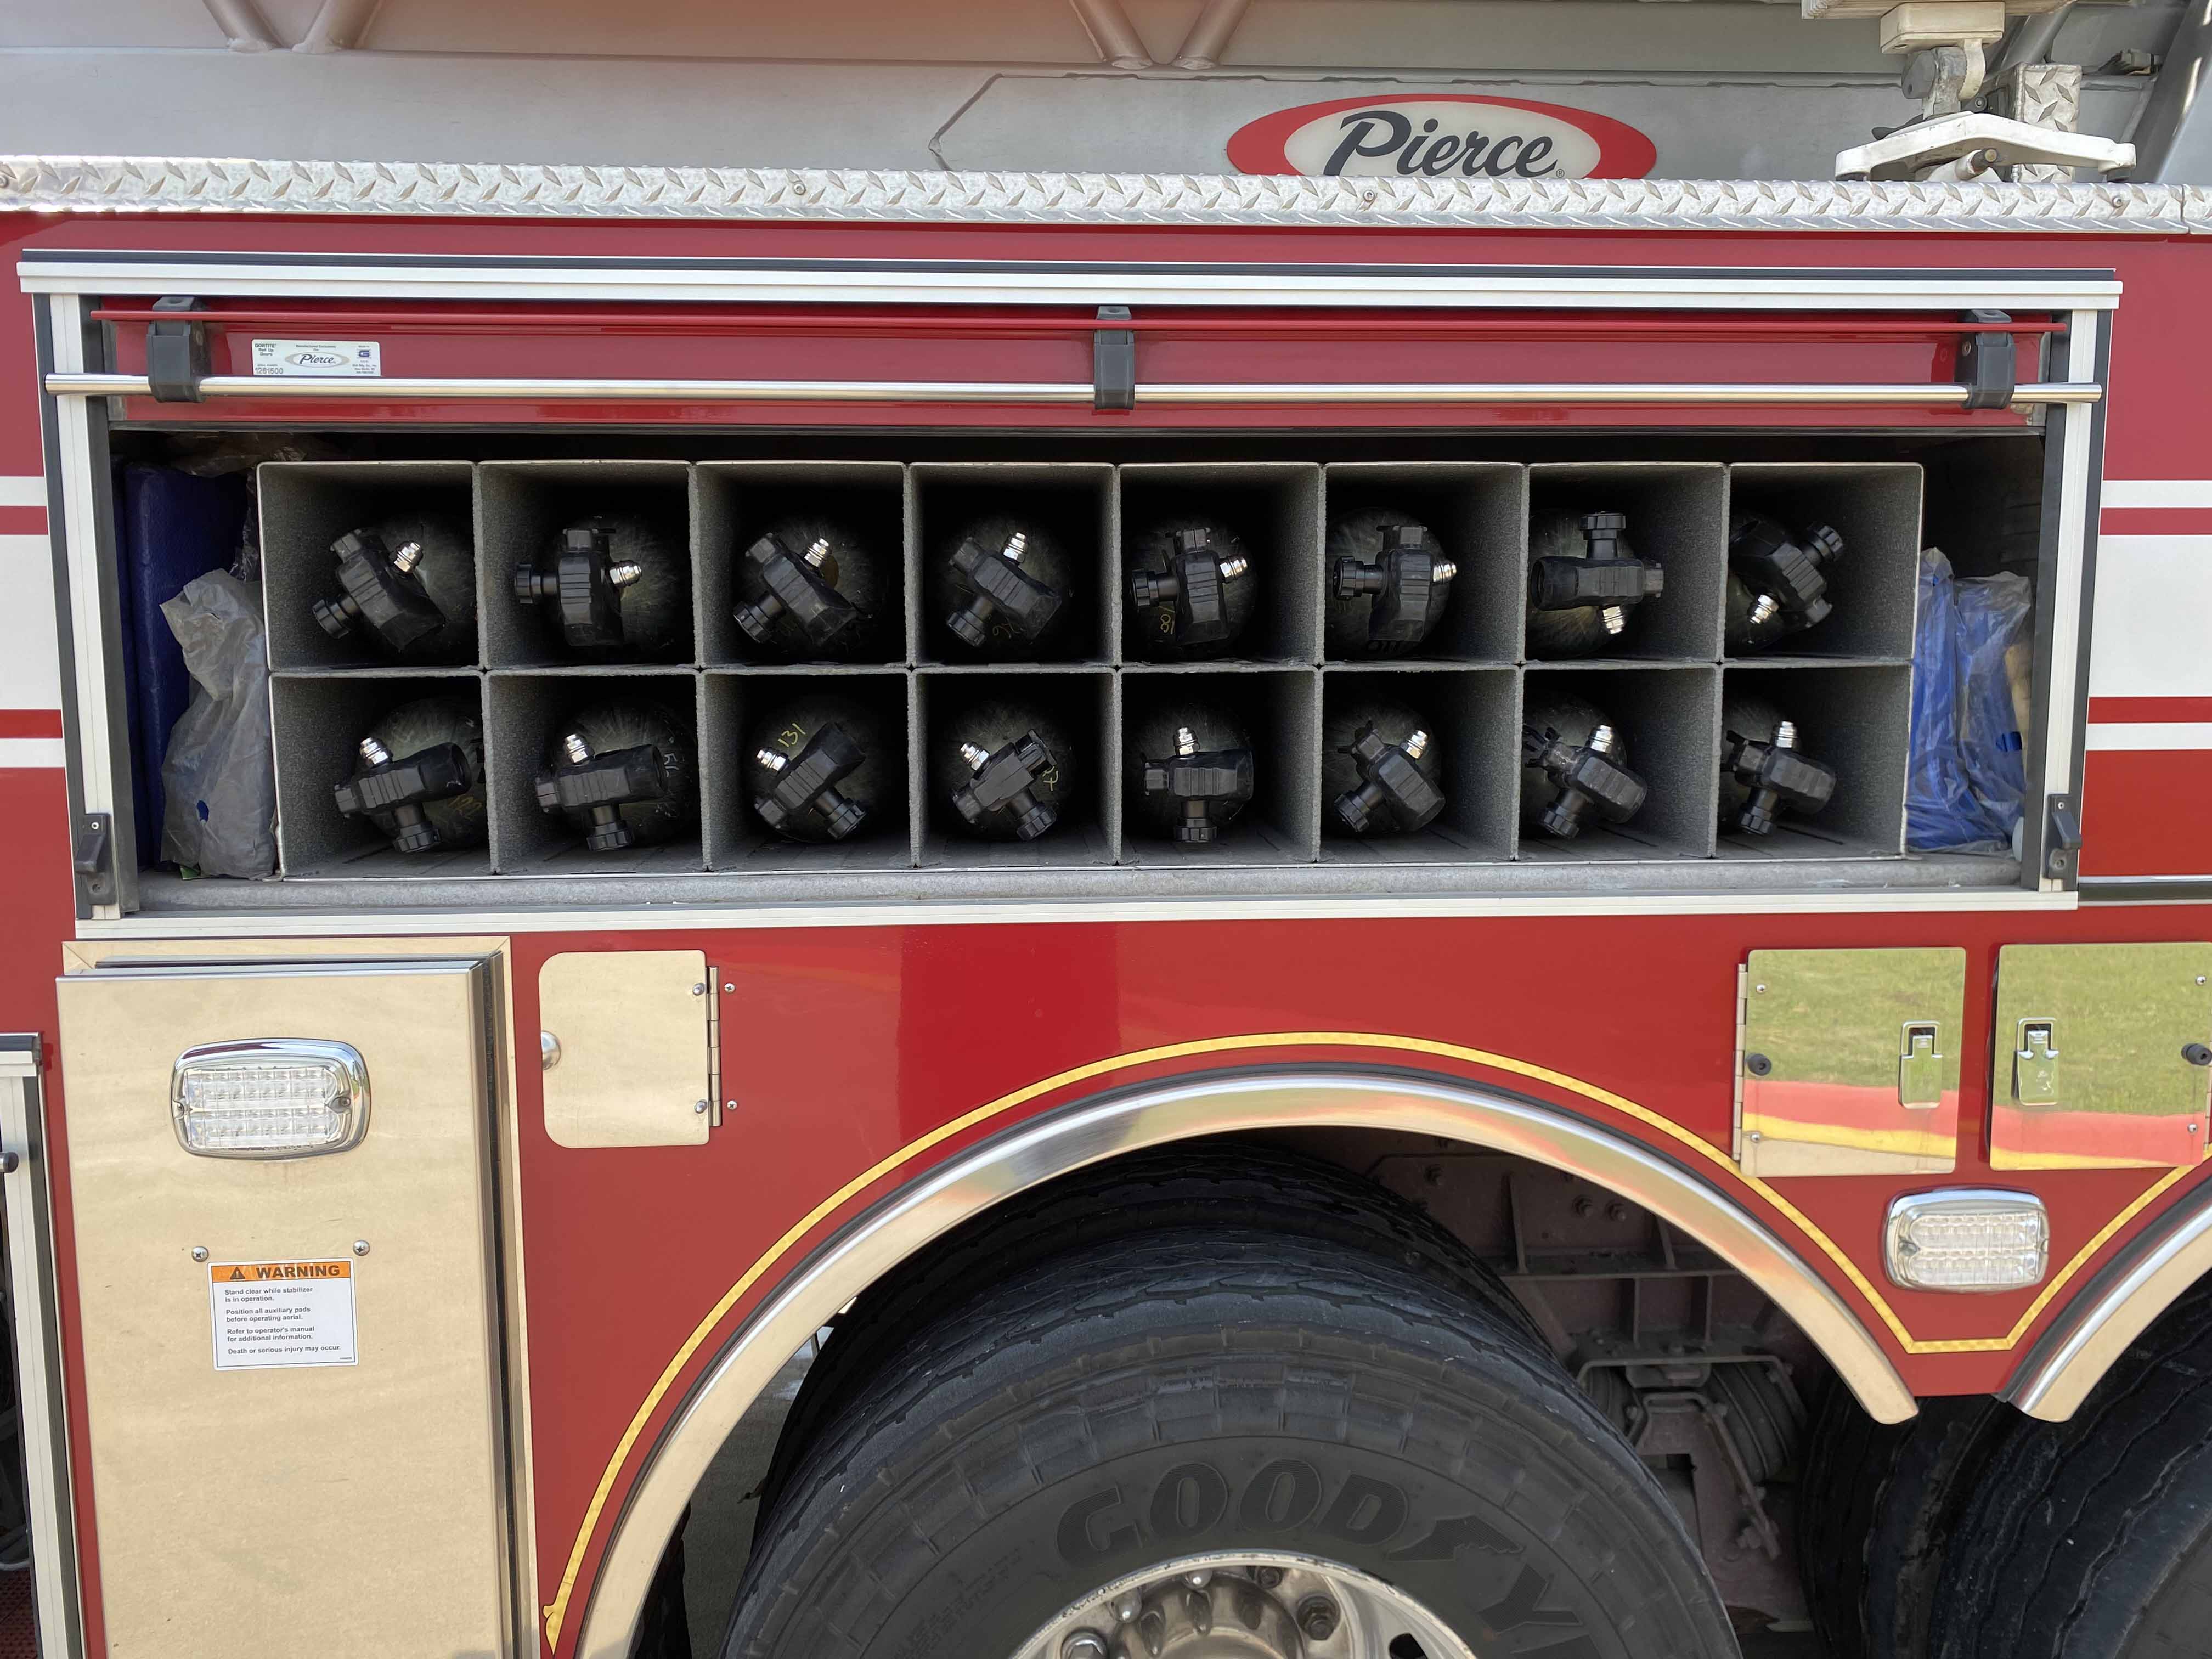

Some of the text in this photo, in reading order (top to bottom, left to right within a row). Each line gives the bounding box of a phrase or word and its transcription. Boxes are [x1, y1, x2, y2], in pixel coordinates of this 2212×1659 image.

[1324, 110, 1559, 178] Pierce
[299, 353, 334, 364] Pierce
[777, 723, 806, 748] 131
[256, 1264, 340, 1279] WARNING
